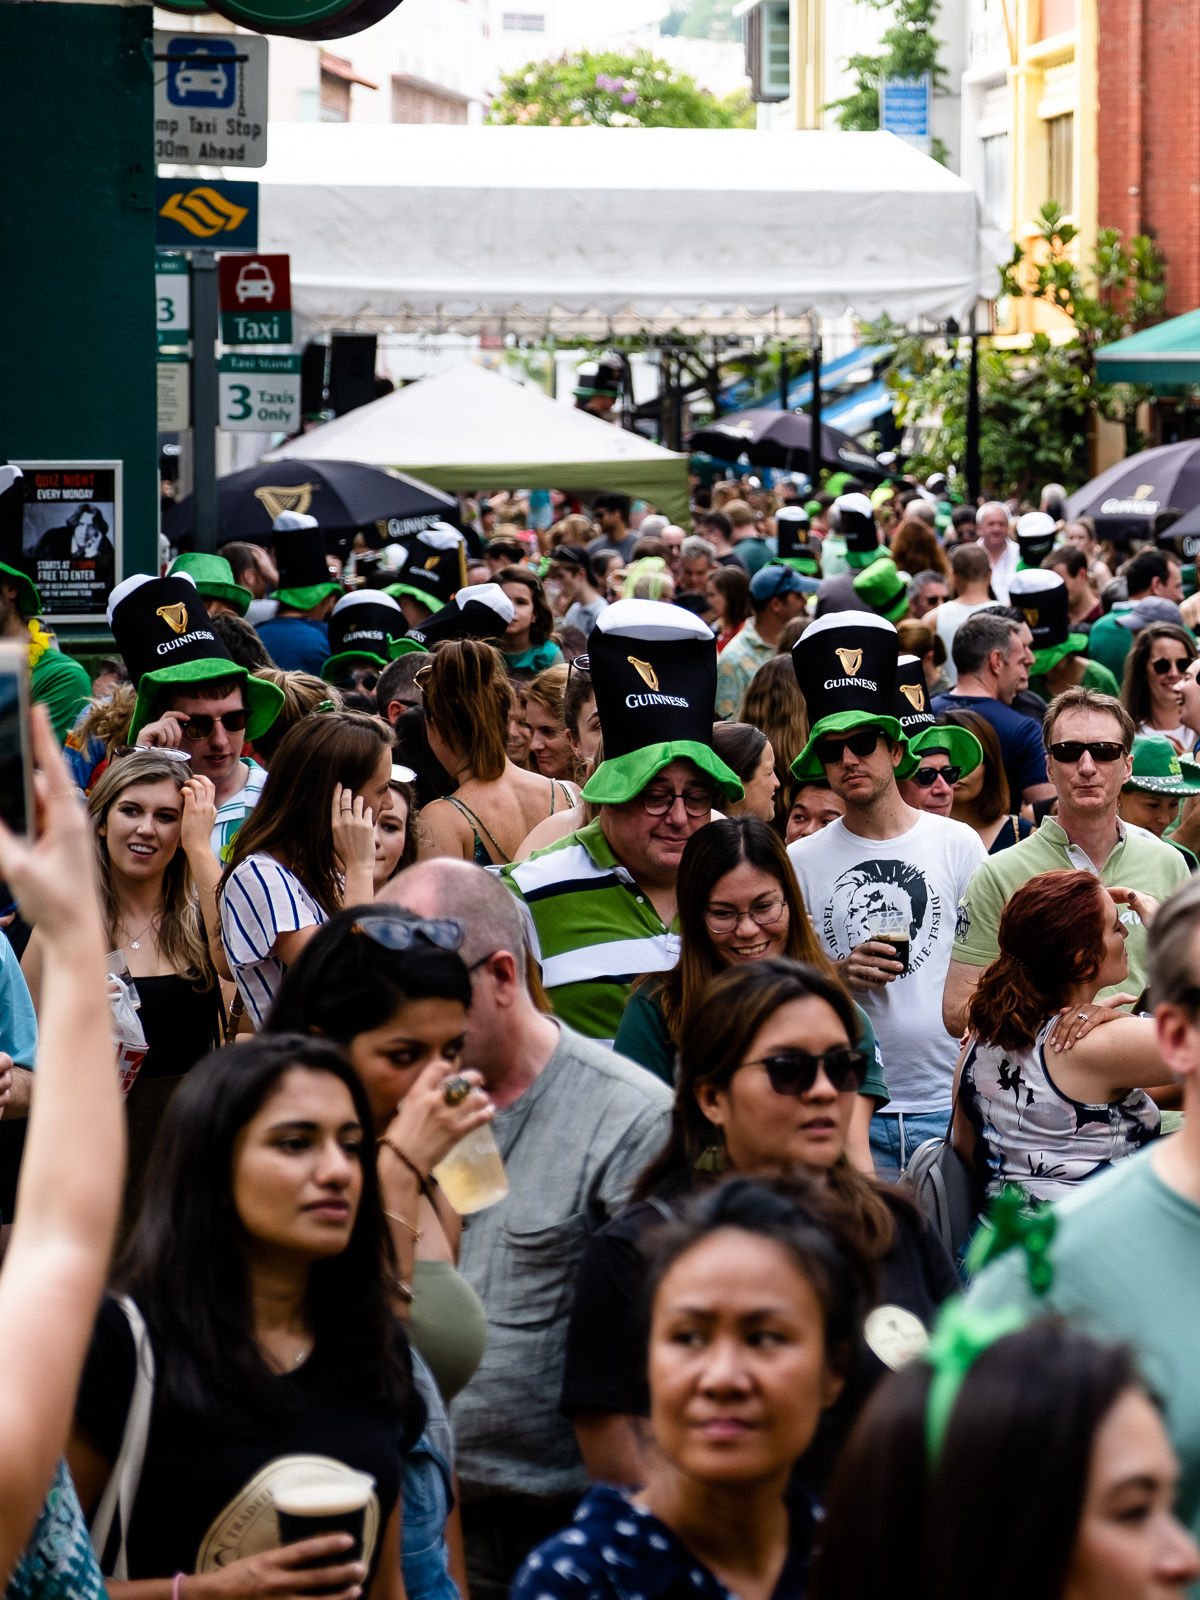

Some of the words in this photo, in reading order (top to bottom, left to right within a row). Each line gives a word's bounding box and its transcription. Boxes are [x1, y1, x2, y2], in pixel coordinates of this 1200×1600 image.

[155, 118, 179, 137] mp
[188, 115, 218, 135] Taxi
[226, 118, 262, 141] Stop
[199, 142, 245, 160] Ahead
[233, 316, 280, 340] Taxi
[230, 357, 256, 368] Taxi
[227, 383, 253, 421] 3
[257, 391, 295, 405] Taxis
[257, 408, 292, 423] Only
[63, 474, 95, 487] NIGHT
[36, 488, 62, 500] EVERY
[62, 488, 94, 500] MONDAY
[37, 570, 57, 581] FREE
[59, 570, 70, 581] TO
[70, 570, 96, 581] ENTER
[156, 630, 215, 655] GUINNESS
[823, 677, 878, 692] GUINNESS
[624, 693, 689, 709] GUINNESS
[823, 904, 838, 949] DIESEL
[928, 895, 942, 943] DIESEL
